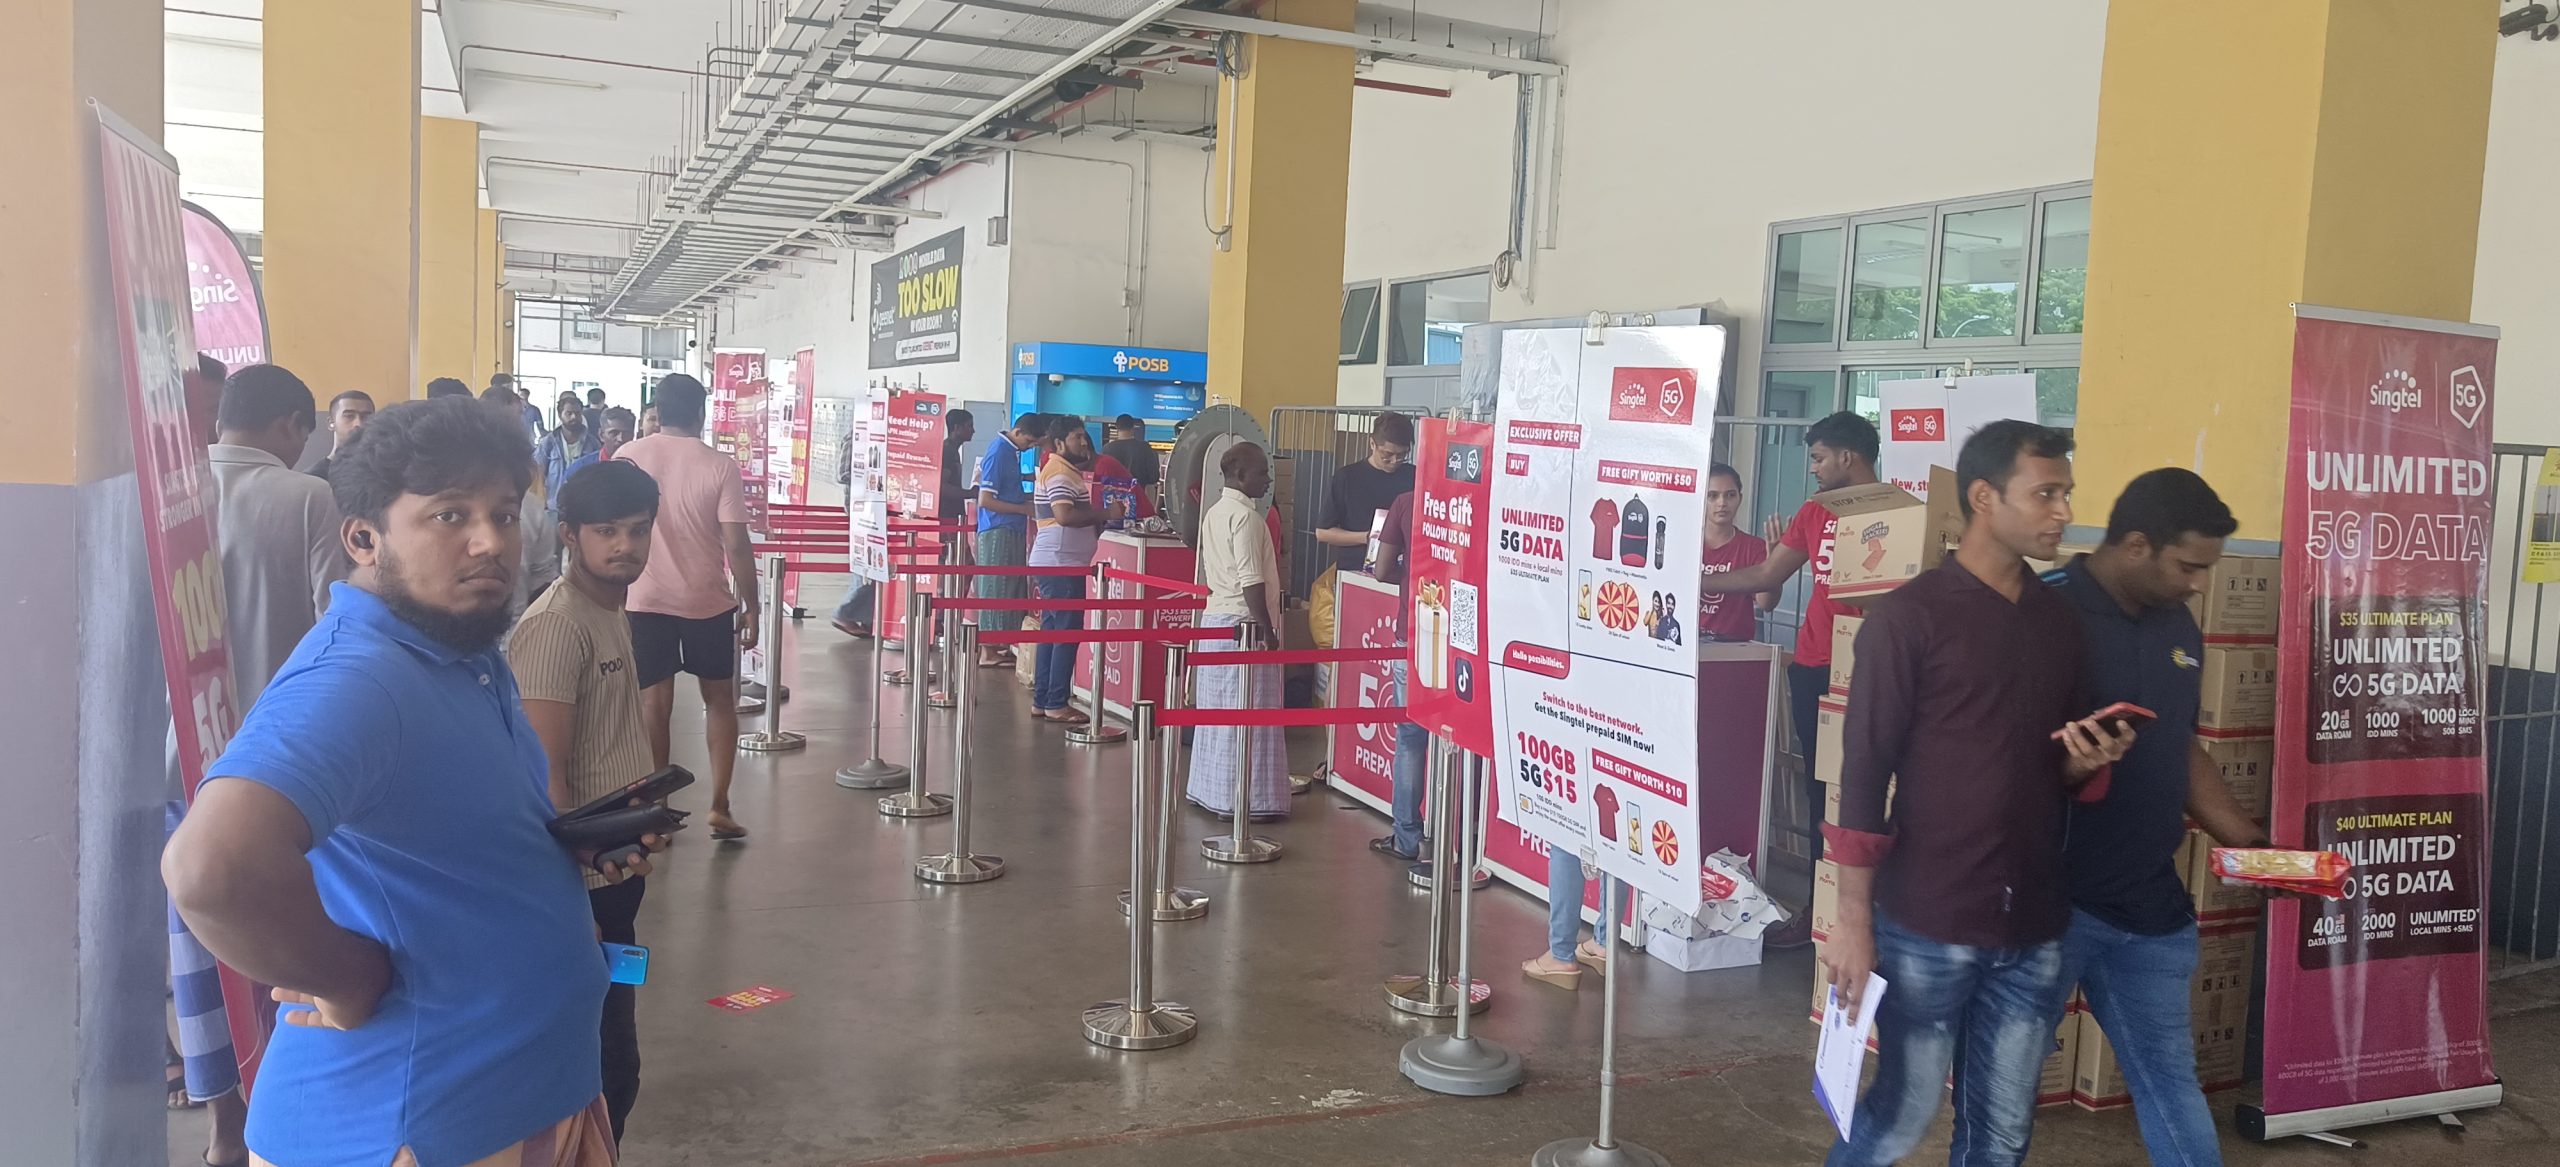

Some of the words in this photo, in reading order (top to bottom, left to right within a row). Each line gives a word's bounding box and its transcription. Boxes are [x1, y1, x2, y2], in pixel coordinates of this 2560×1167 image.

[898, 278, 920, 318] TOO
[922, 265, 958, 313] SLOW
[1128, 357, 1169, 372] POSB
[1619, 393, 1646, 408] Singtel
[1664, 390, 1678, 404] 5G
[2370, 385, 2422, 412] Singtel
[2455, 384, 2476, 408] 5G
[909, 418, 934, 431] Help?
[1510, 426, 1552, 441] EXCLUSIVE
[1554, 430, 1579, 443] OFFER
[1510, 459, 1525, 470] BUY
[2308, 451, 2486, 496] UNLIMITED
[1601, 466, 1620, 478] FREE
[1621, 468, 1639, 480] GIFT
[1641, 470, 1672, 484] WORTH
[1674, 473, 1692, 486] $50
[1424, 492, 1446, 520] Free
[1449, 496, 1472, 526] Gift
[1502, 507, 1564, 533] UNLIMITED
[1422, 522, 1448, 541] FOLLOW
[1448, 528, 1458, 544] US
[1459, 532, 1470, 548] ON
[2306, 511, 2360, 560] 5G
[2370, 513, 2486, 561] DATA
[1431, 544, 1456, 564] TIKTOK.
[1500, 530, 1520, 552] 5G
[1522, 534, 1563, 561] DATA
[2340, 612, 2358, 626] $35
[2361, 612, 2417, 626] ULTIMATE
[2421, 612, 2453, 626] PLAN
[1512, 650, 1527, 661] Hello
[2334, 638, 2460, 665] UNLIMITED
[2368, 672, 2395, 696] 5G
[2402, 672, 2461, 695] DATA
[1542, 692, 1566, 708] Switch
[1567, 701, 1574, 710] to
[1576, 702, 1588, 714] the
[1590, 707, 1605, 722] best
[1607, 714, 1644, 736] network.
[2321, 711, 2339, 730] 20
[2366, 712, 2400, 728] 1000
[2422, 708, 2456, 724] 1000
[1534, 702, 1546, 713] Get
[1546, 706, 1558, 718] the
[1560, 710, 1584, 728] Singtel
[1586, 722, 1614, 740] prepaid
[1616, 732, 1632, 745] SIM
[1634, 740, 1654, 754] now!
[2316, 731, 2332, 740] DATA
[2334, 730, 2351, 740] ROAM
[2380, 730, 2398, 738] MINS
[2458, 726, 2472, 734] SMS
[1518, 731, 1576, 774] 100GB
[1356, 746, 1392, 780] PREPA
[1596, 755, 1614, 770] FREE
[1615, 763, 1632, 776] GIFT
[1633, 770, 1664, 790] WORTH
[1666, 782, 1682, 798] $10
[2336, 816, 2355, 832] $40
[2358, 813, 2416, 829] ULTIMATE
[2420, 811, 2452, 826] PLAN
[2362, 874, 2390, 898] 5G
[2396, 870, 2454, 895] DATA
[2313, 916, 2334, 936] 40
[2362, 912, 2396, 931] 2000
[2410, 927, 2432, 936] LOCAL
[2433, 926, 2451, 934] MINS
[2308, 937, 2326, 947] DATA
[2328, 935, 2347, 945] ROAM
[2376, 930, 2394, 940] MINS
